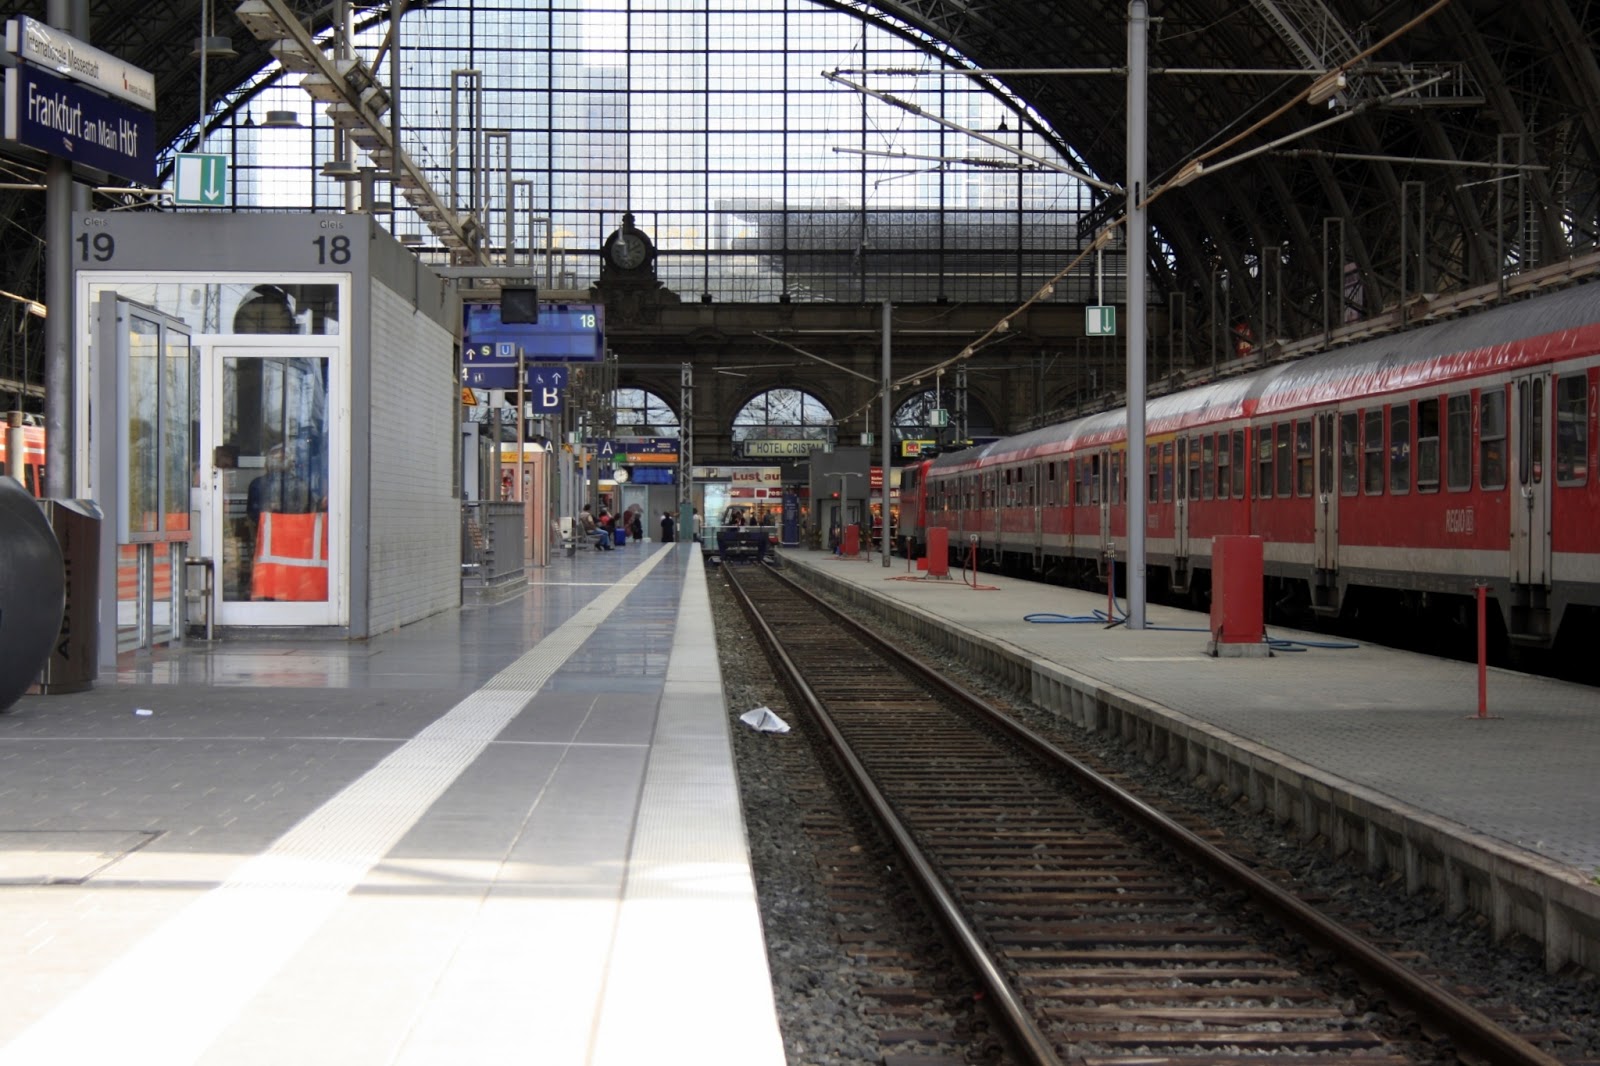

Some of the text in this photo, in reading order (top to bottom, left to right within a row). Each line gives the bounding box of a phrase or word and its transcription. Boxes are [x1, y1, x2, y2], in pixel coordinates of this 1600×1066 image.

[26, 32, 99, 79] Internationale Messestadt
[28, 82, 82, 138] Frankfurt
[84, 120, 97, 143] am
[98, 119, 118, 150] Main
[119, 118, 138, 157] Hbf
[84, 217, 108, 226] Gleis
[320, 220, 344, 229] Gleis
[76, 232, 115, 262] 19
[312, 235, 352, 265] 18
[580, 314, 596, 328] 18
[481, 345, 491, 356] S
[542, 388, 559, 407] B
[1590, 386, 1597, 418] 2
[602, 441, 613, 454] A
[757, 443, 784, 453] HOTEL
[732, 471, 761, 481] Lust
[1446, 509, 1465, 533] REGIO
